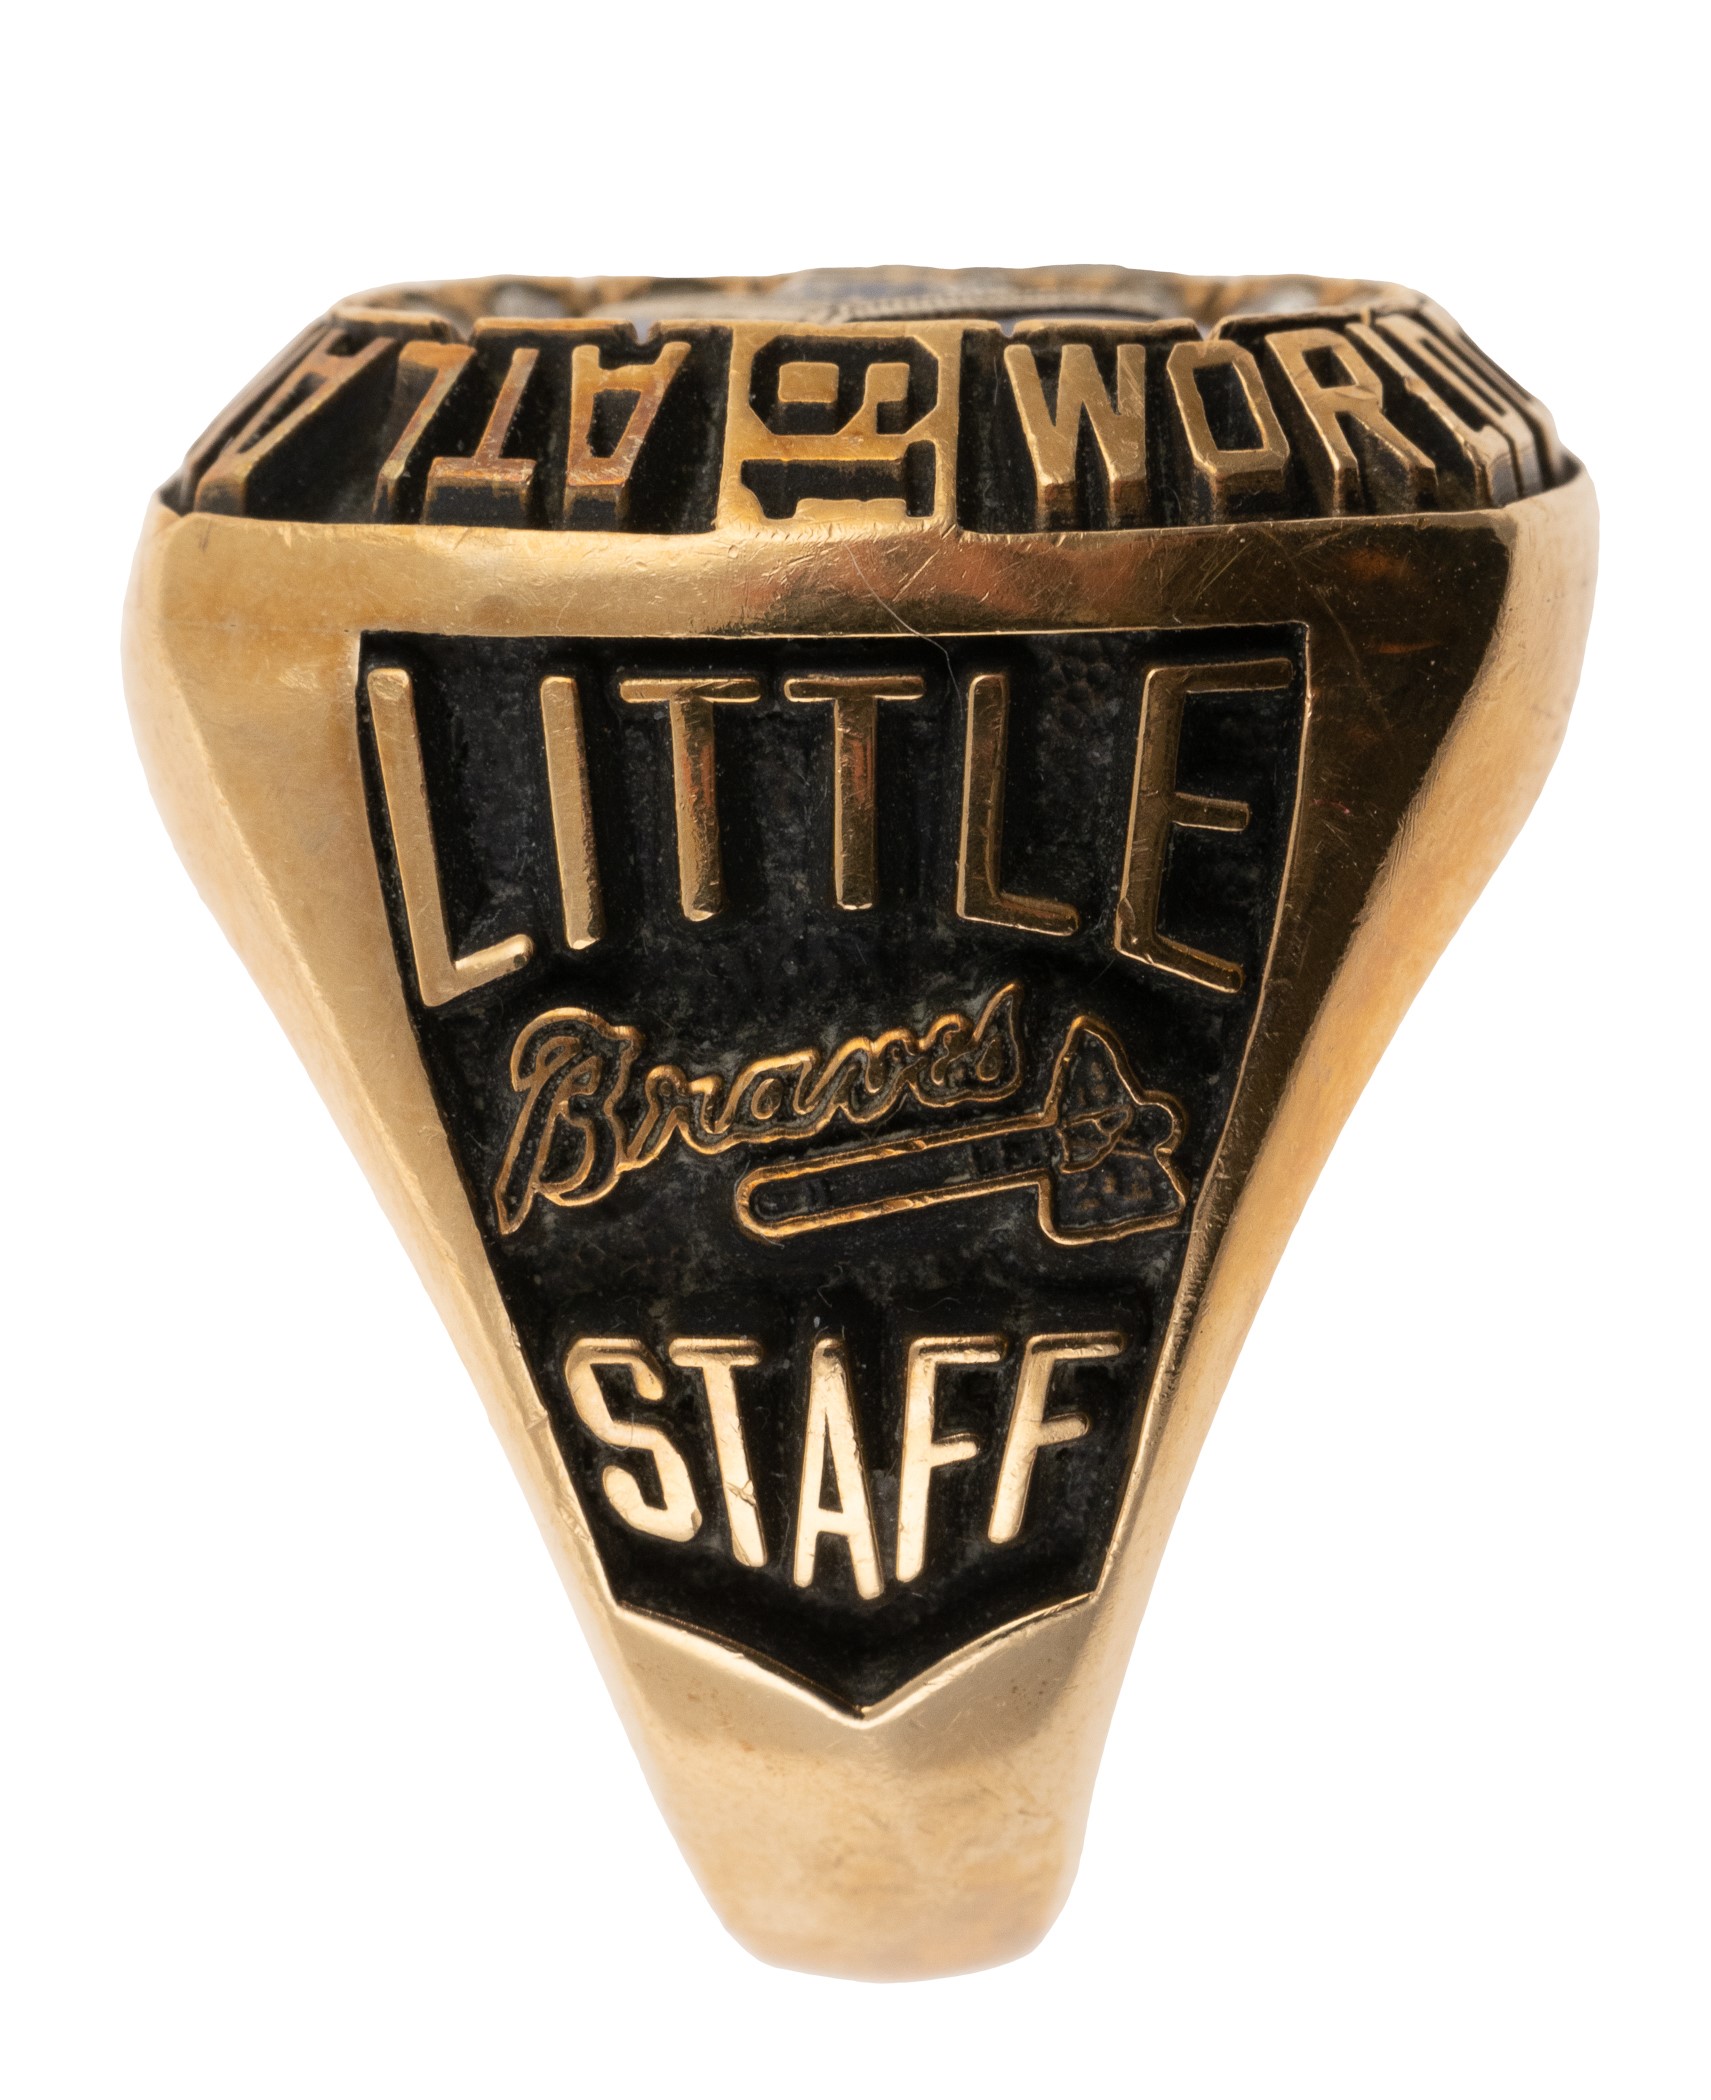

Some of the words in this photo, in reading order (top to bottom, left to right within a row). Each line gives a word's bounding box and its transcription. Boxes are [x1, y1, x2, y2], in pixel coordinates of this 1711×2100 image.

[180, 325, 692, 488] ATLA
[740, 334, 939, 519] 19
[1004, 315, 1537, 486] WORLD
[366, 657, 1293, 1007] LITTLE
[494, 982, 1022, 1235] Braves
[564, 1331, 1127, 1599] STAFF
